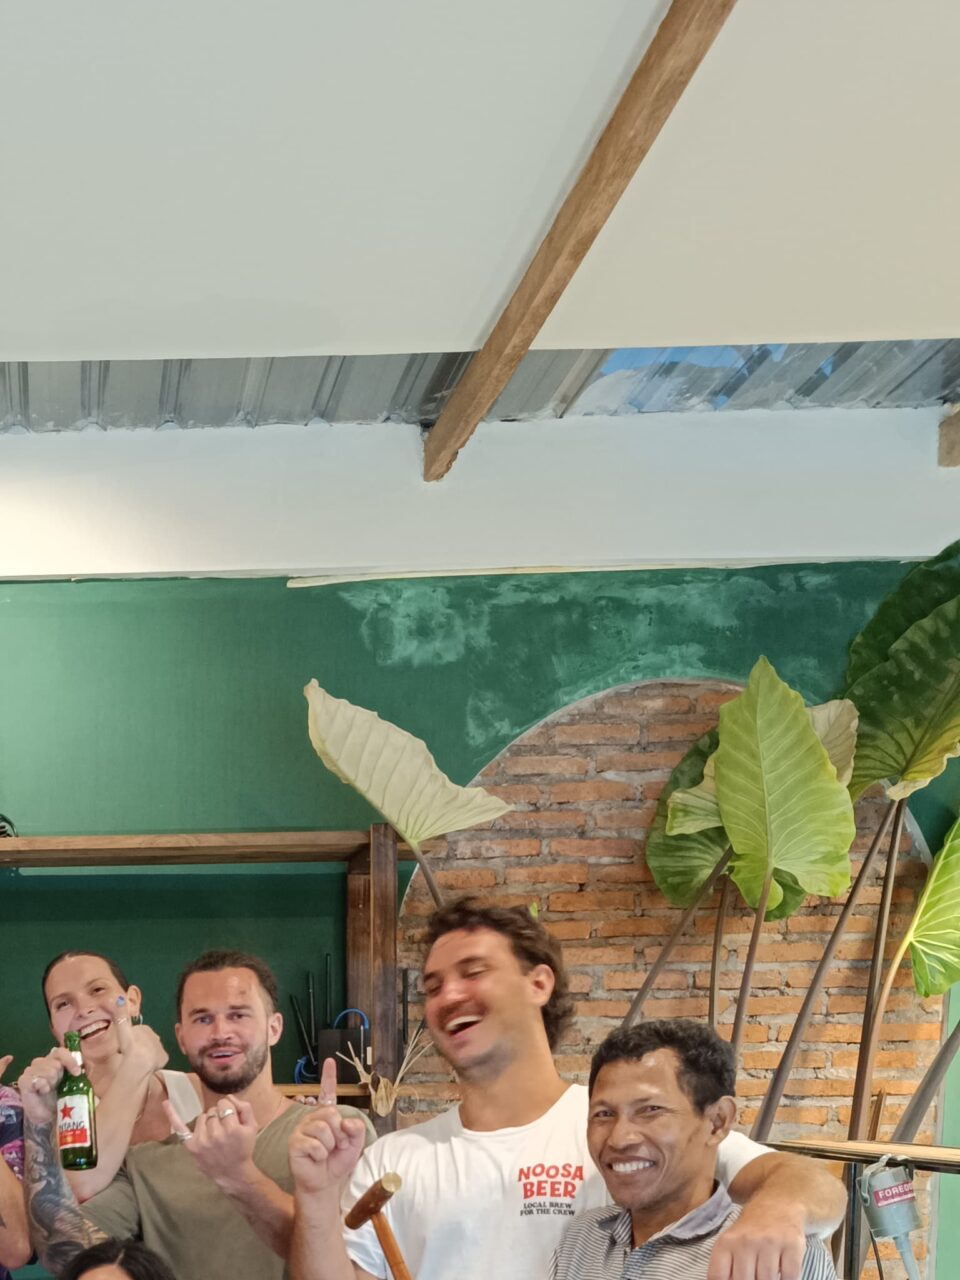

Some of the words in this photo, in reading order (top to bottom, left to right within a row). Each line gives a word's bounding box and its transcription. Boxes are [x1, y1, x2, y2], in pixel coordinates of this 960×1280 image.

[517, 1163, 584, 1182] NOOSA
[523, 1180, 576, 1200] BEER
[523, 1201, 546, 1209] LOCAL
[549, 1201, 572, 1209] BREW
[553, 1208, 576, 1216] CREW
